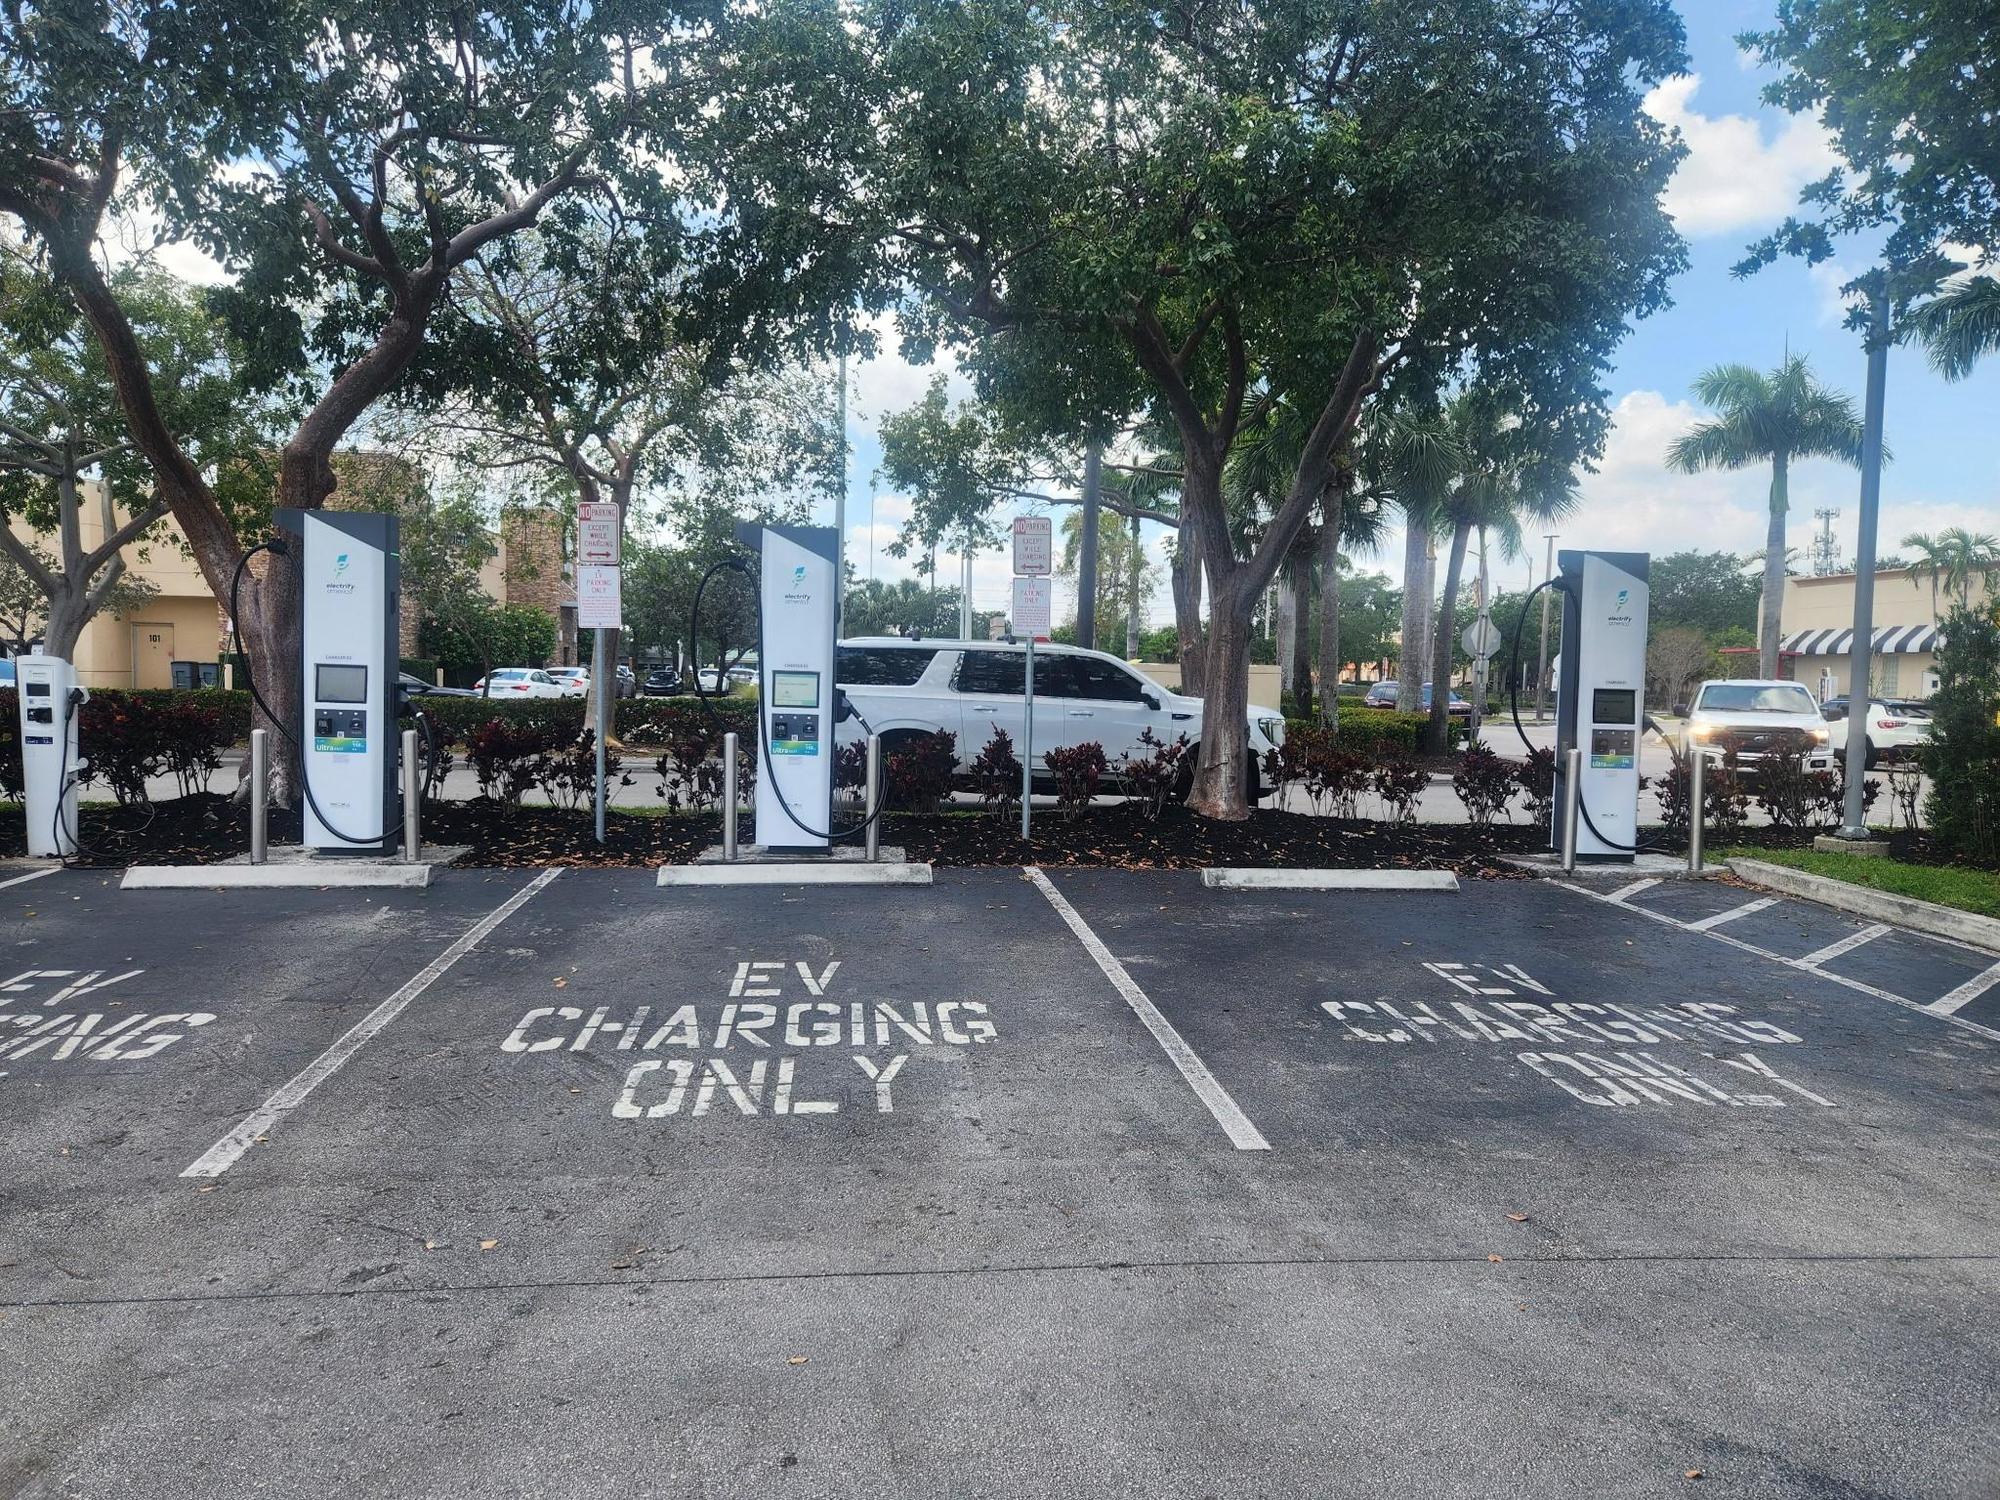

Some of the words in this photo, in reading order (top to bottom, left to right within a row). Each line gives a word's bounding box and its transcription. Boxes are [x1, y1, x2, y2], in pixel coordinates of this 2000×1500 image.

[579, 506, 591, 519] NO
[592, 508, 616, 517] PARKING
[149, 634, 161, 643] 101
[728, 961, 842, 997] EV
[1421, 962, 1557, 996] EV
[500, 1001, 999, 1053] CHARGING
[1320, 1001, 1804, 1045] CHARGING
[611, 1054, 909, 1119] ONLY
[1516, 1051, 1838, 1107] ONLY
